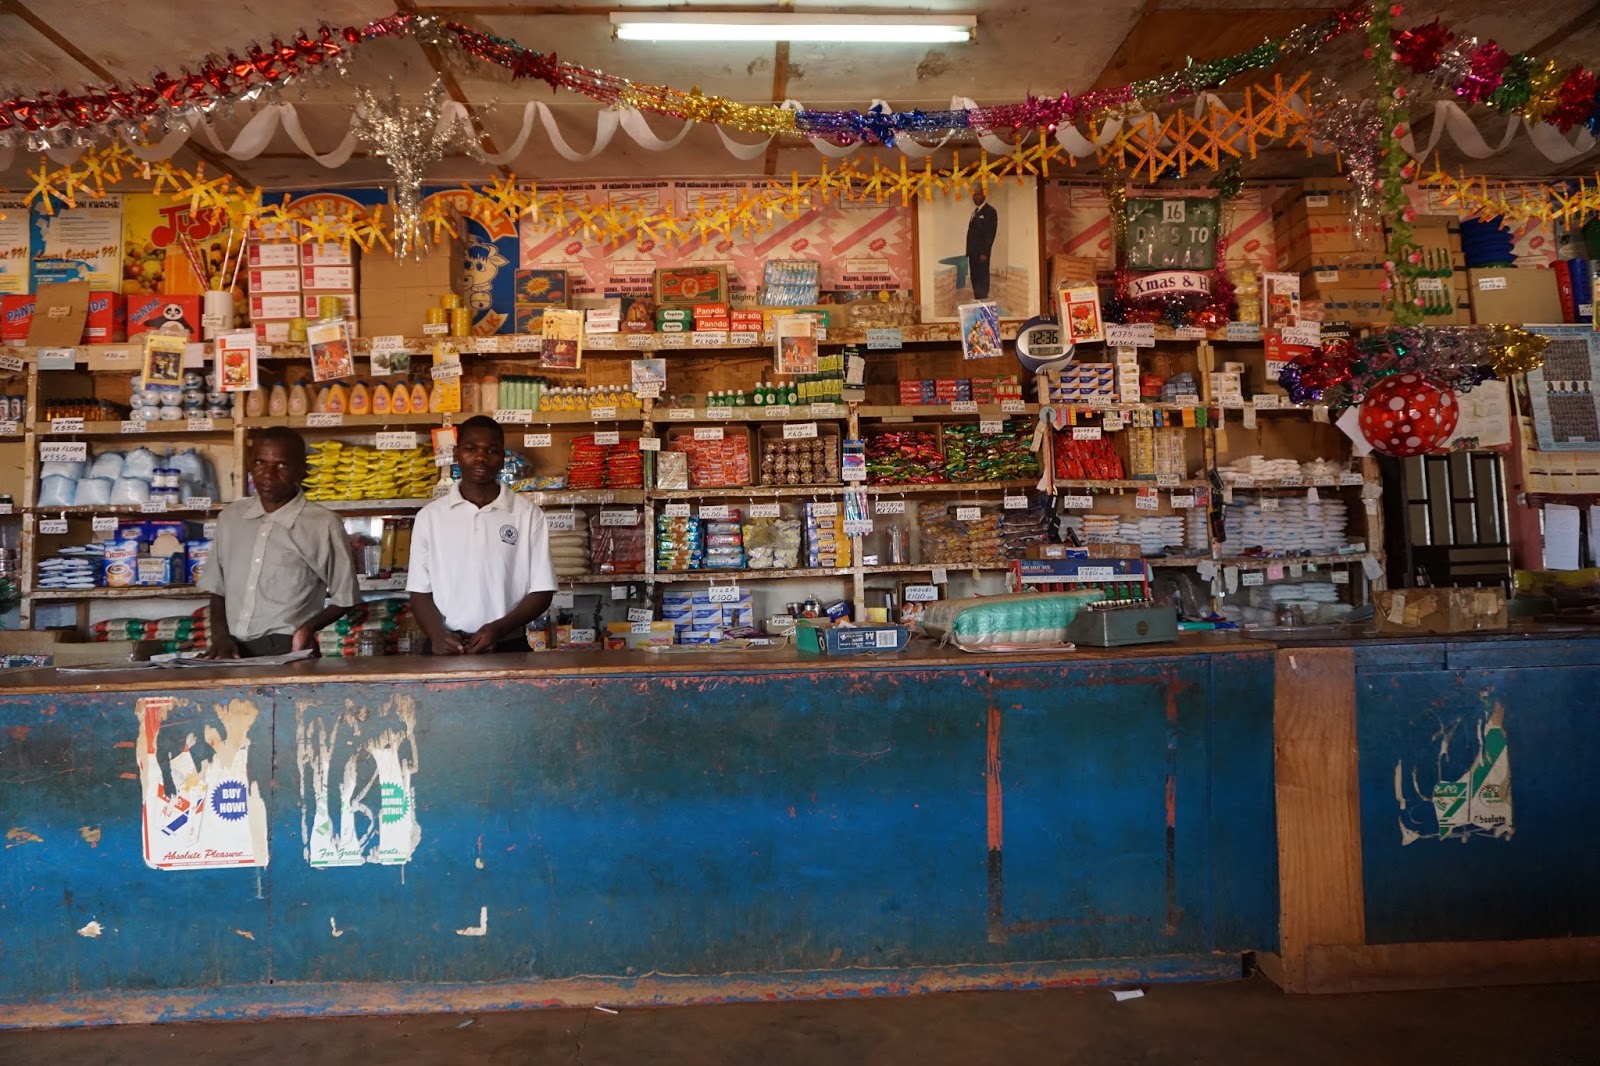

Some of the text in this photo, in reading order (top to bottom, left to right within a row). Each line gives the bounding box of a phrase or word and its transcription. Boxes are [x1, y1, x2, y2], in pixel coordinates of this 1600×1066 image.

[1167, 205, 1181, 219] 16
[1136, 226, 1180, 245] DAYS
[1189, 226, 1209, 243] TO
[1136, 276, 1176, 294] Xmas
[1183, 274, 1194, 288] &
[732, 294, 755, 303] Mighty
[131, 298, 160, 323] PANDA
[696, 307, 725, 317] Panado
[699, 319, 728, 330] Panado
[1033, 331, 1059, 345] 12:36
[222, 788, 241, 800] BUY
[219, 801, 247, 814] NOW!
[162, 851, 202, 860] Absolute
[318, 848, 334, 859] For
[338, 848, 361, 860] Great
